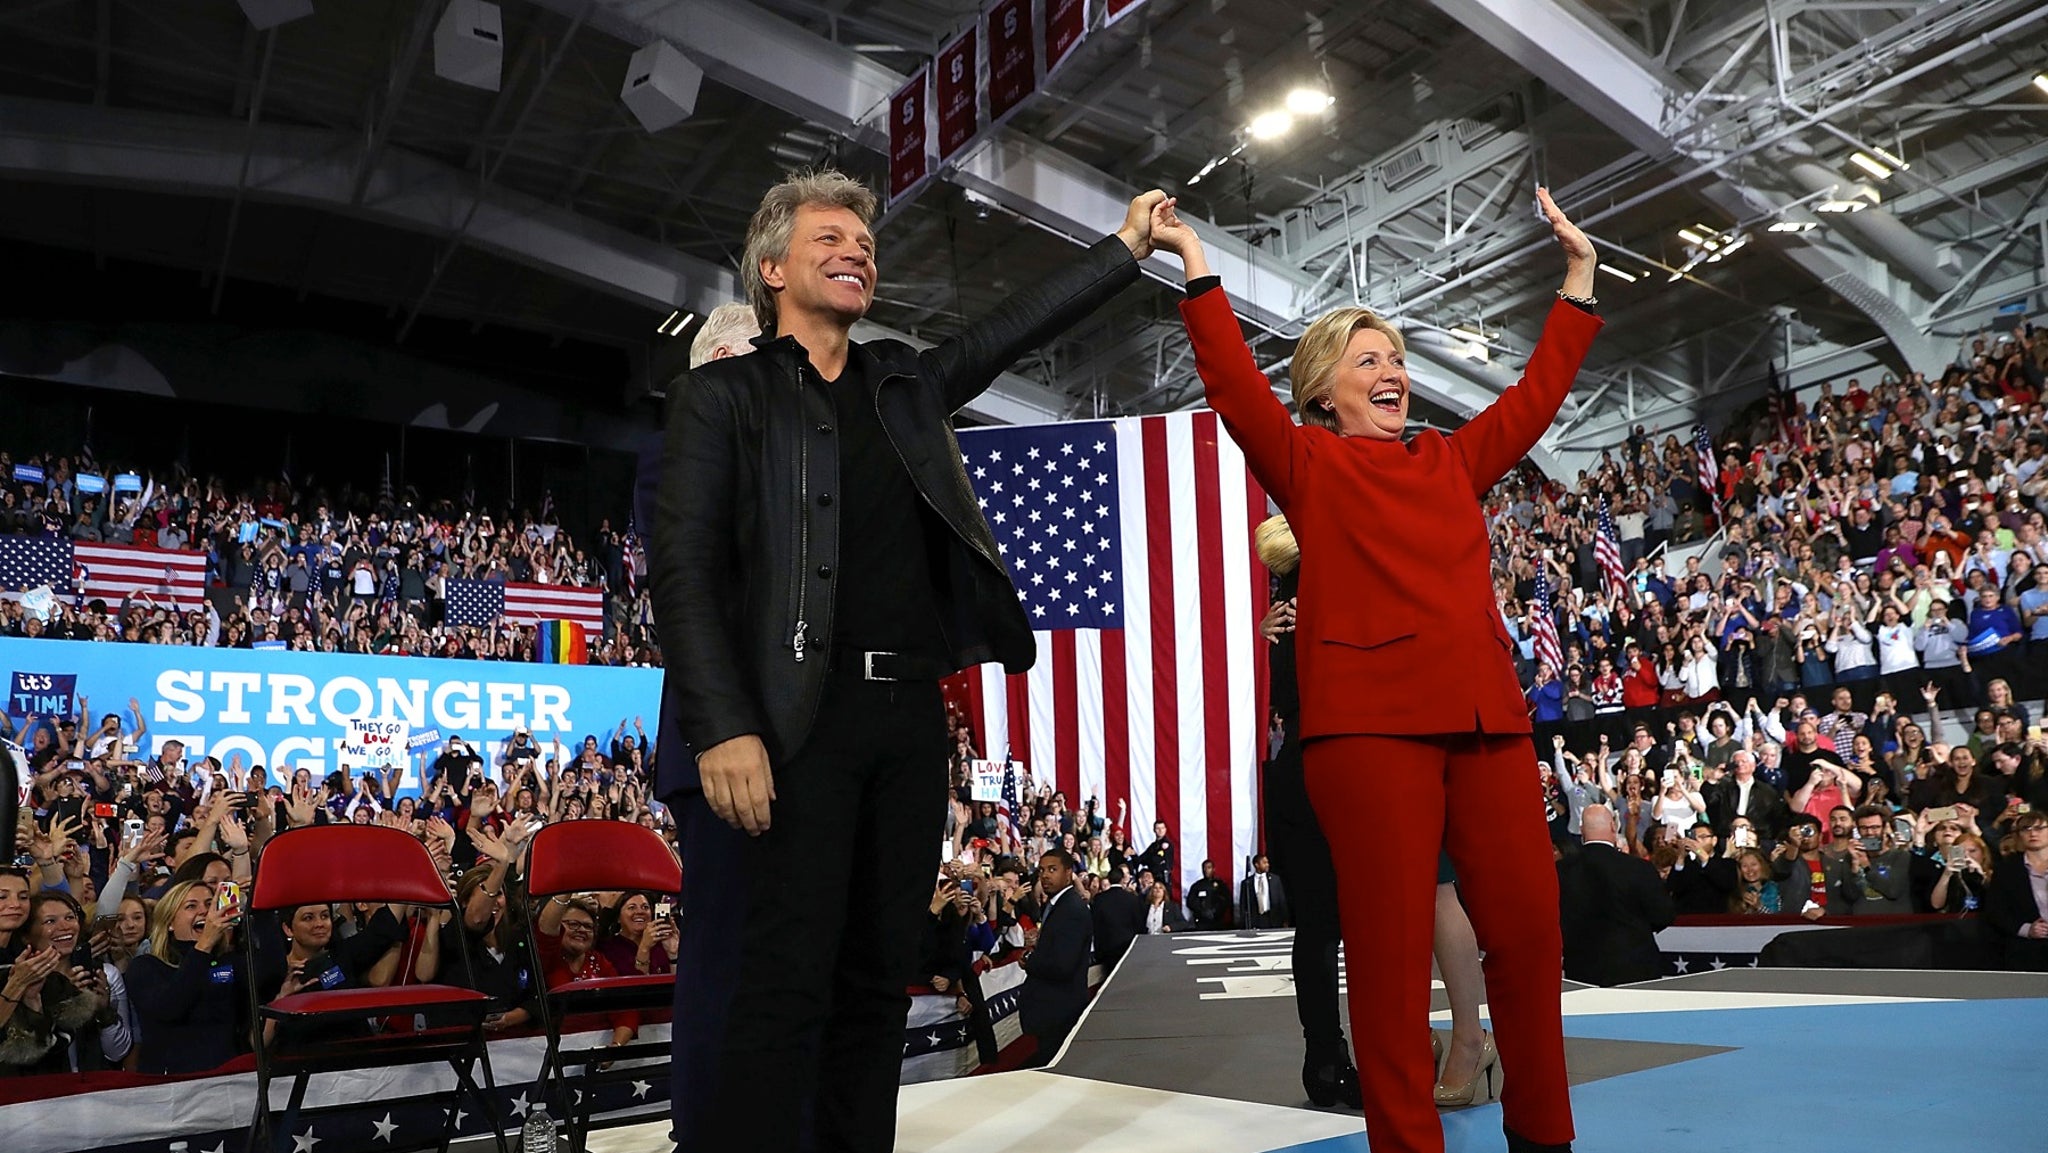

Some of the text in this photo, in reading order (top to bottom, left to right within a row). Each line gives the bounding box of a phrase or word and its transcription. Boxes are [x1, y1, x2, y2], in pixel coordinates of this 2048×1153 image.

[14, 693, 68, 715] TIME
[154, 670, 572, 731] STRONGER
[350, 718, 401, 734] THEY GO
[347, 745, 391, 757] WE GO
[980, 775, 1023, 786] TRUS
[981, 787, 1001, 799] HA
